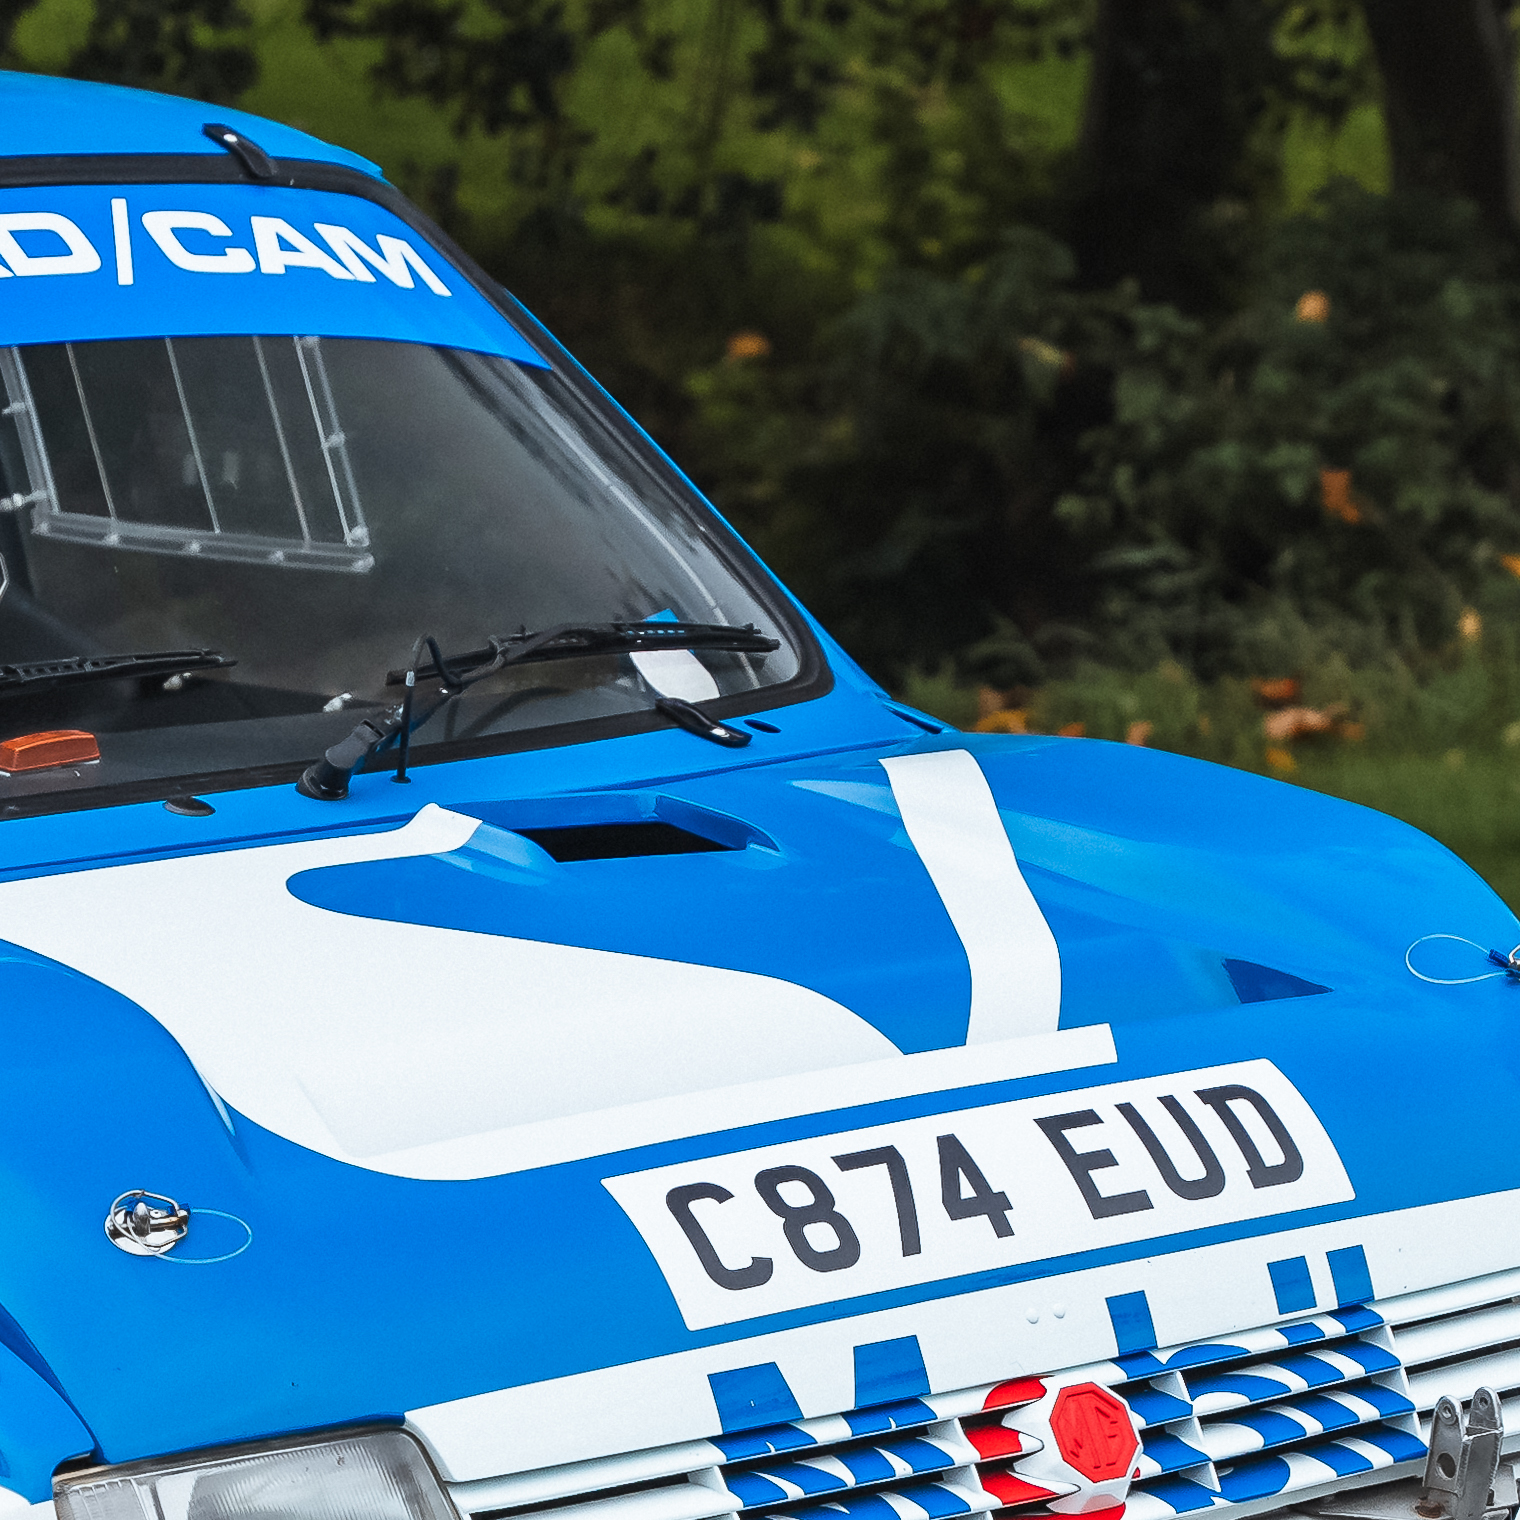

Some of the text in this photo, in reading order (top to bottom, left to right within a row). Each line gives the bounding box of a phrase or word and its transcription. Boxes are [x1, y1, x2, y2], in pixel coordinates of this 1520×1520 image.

[665, 1083, 1305, 1292] C874 EUD
[1065, 1400, 1123, 1470] MG
